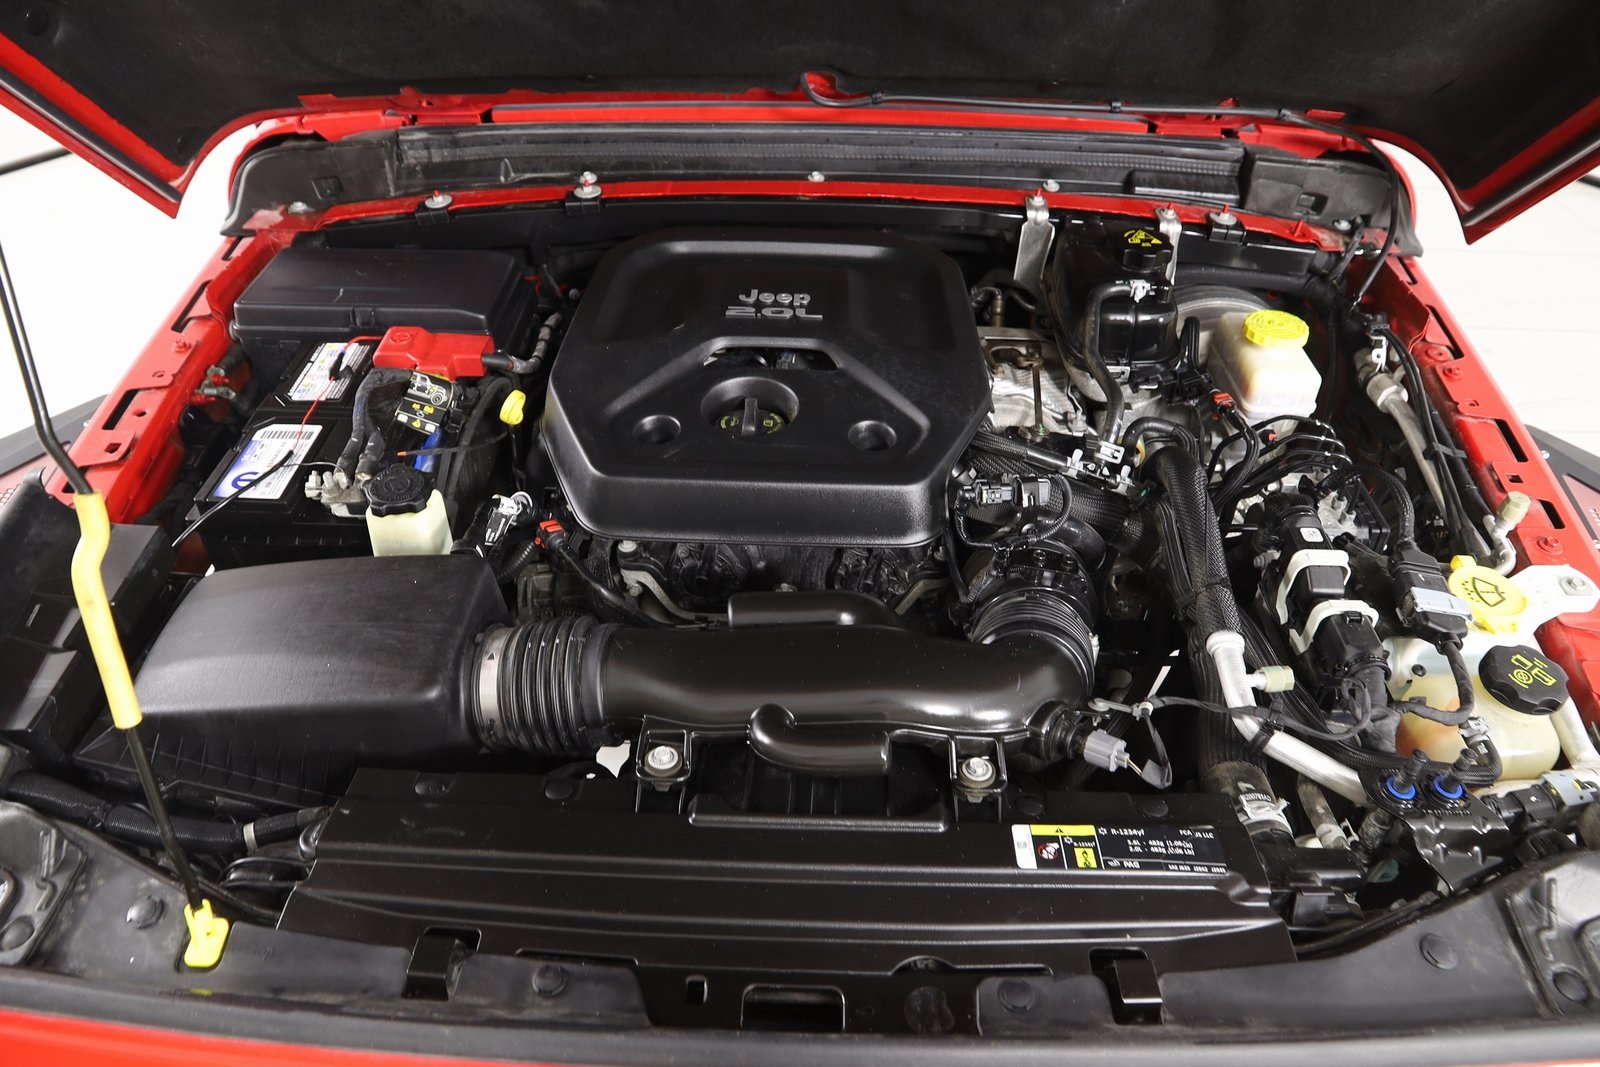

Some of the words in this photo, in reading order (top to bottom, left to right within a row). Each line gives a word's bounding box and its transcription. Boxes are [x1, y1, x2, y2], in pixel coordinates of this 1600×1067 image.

[738, 289, 811, 306] Jeep
[725, 305, 823, 320] 2.0L
[1110, 827, 1145, 837] R-1234yf
[1202, 831, 1215, 840] LLC
